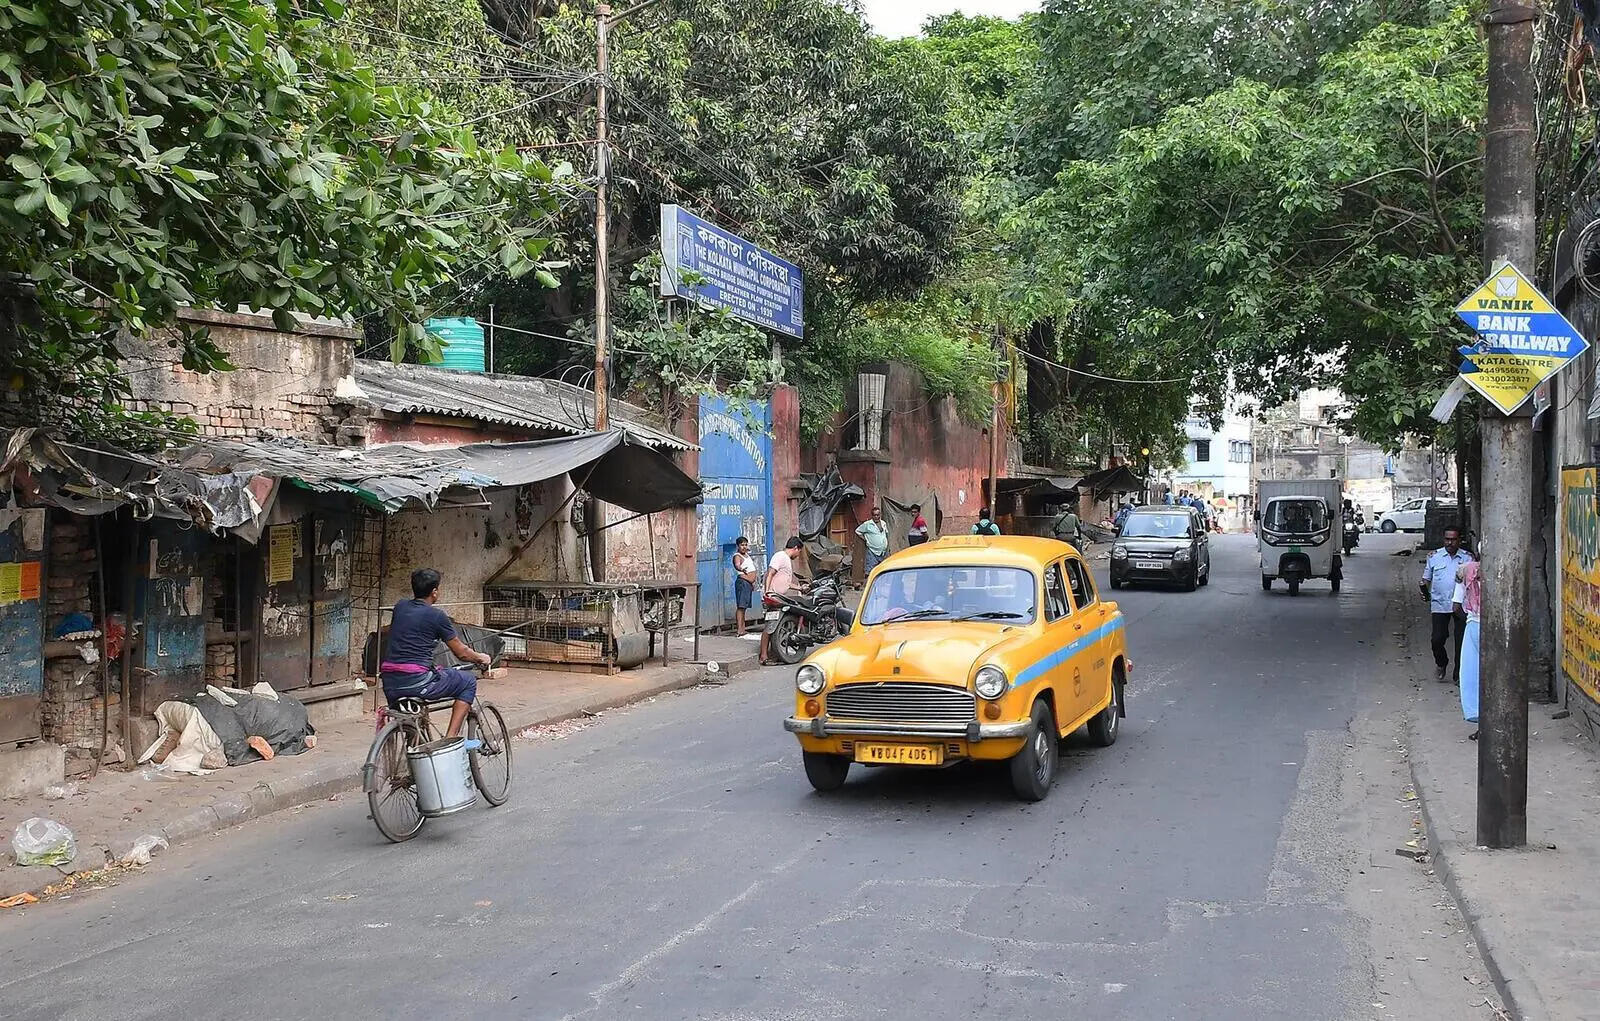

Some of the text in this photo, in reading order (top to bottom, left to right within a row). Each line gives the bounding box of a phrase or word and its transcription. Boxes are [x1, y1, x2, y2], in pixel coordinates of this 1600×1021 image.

[696, 225, 743, 261] কলকাতা
[695, 243, 790, 297] THE KOLKATA MUNICIPAL CORPORATION
[721, 270, 736, 284] BRIDGE
[737, 276, 756, 292] DRAINAGE
[719, 290, 746, 308] ERECTED
[747, 301, 756, 311] ON
[760, 306, 773, 318] 1939
[726, 283, 750, 299] WEATHER
[750, 293, 763, 305] FLOW
[764, 299, 783, 312] STATION
[1478, 299, 1534, 310] VANIK
[757, 315, 777, 328] KOLKATA
[1477, 315, 1531, 332] BANK
[1509, 358, 1553, 368] CENTRE
[740, 429, 765, 473] STATION
[735, 484, 759, 501] STATION
[728, 504, 741, 515] 1939
